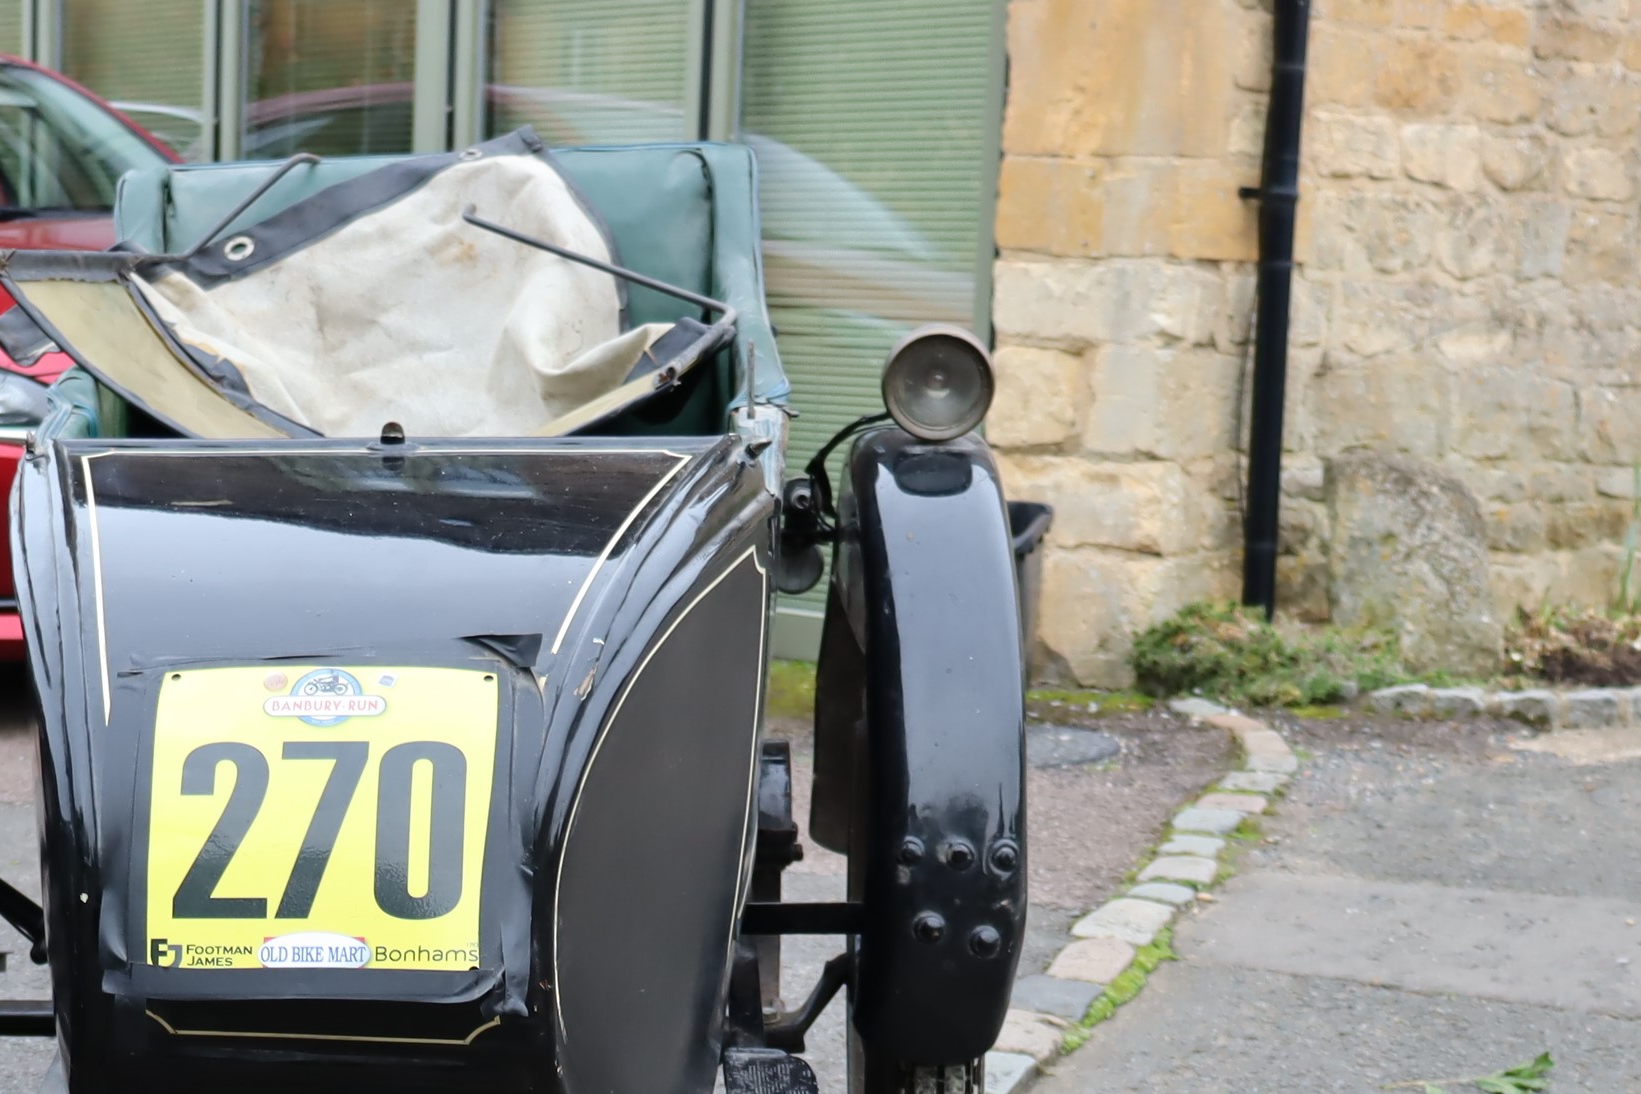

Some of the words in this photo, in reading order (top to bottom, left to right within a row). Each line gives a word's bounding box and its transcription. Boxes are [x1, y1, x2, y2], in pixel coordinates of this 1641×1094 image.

[272, 699, 342, 712] BANBURY
[348, 699, 379, 711] RUN
[172, 740, 468, 920] 270
[186, 944, 253, 955] FOOTMAN
[260, 945, 288, 963] OLD
[291, 945, 324, 963] BIKE
[328, 946, 367, 963] MART
[374, 946, 479, 962] Bonhams
[187, 956, 233, 967] JAMES
